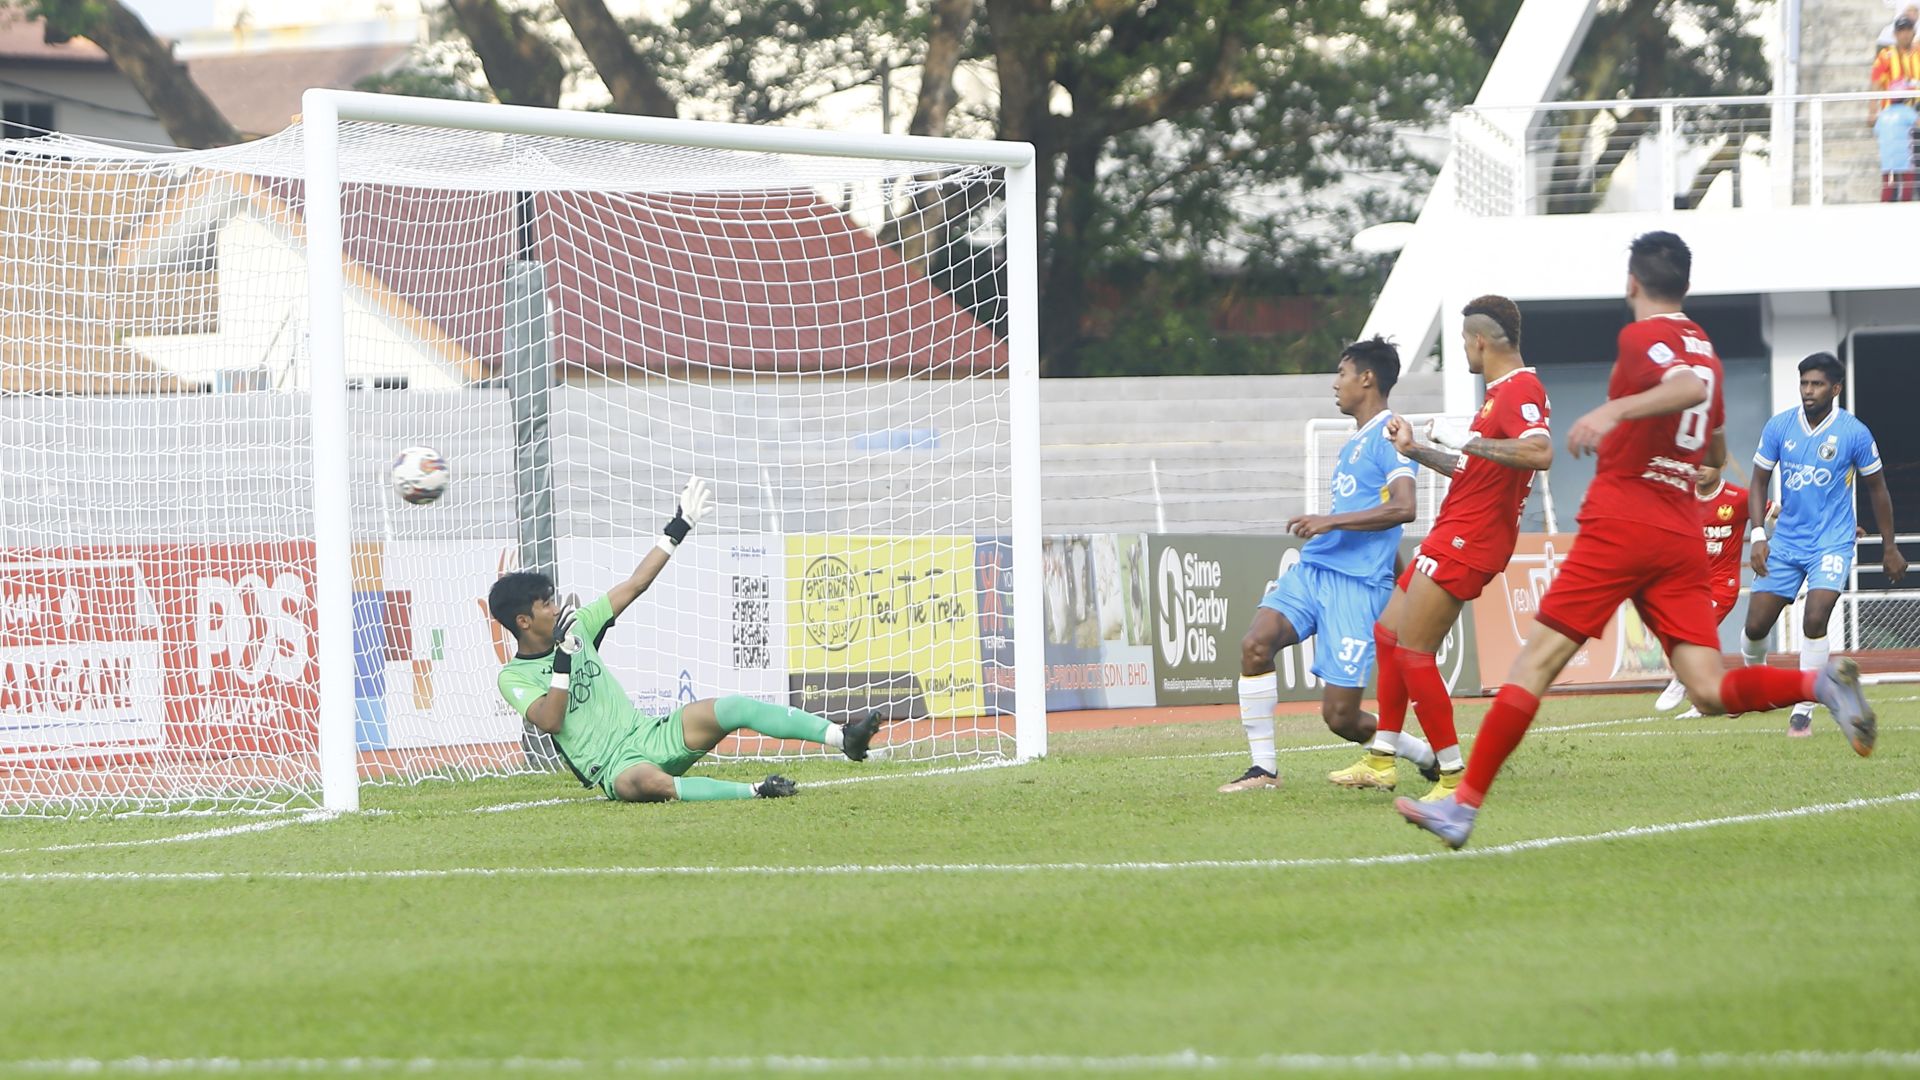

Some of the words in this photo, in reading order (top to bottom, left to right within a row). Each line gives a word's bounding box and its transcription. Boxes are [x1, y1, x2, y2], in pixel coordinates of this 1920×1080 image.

[1332, 471, 1357, 497] 30
[1783, 464, 1832, 490] 2030
[1184, 552, 1221, 587] Sime
[1415, 554, 1438, 577] 10
[1820, 554, 1844, 574] 26
[1186, 590, 1228, 631] Darby
[1187, 627, 1217, 662] Oils
[1339, 636, 1367, 663] 37
[1103, 663, 1126, 687] SDN.
[1127, 662, 1150, 686] BHD.
